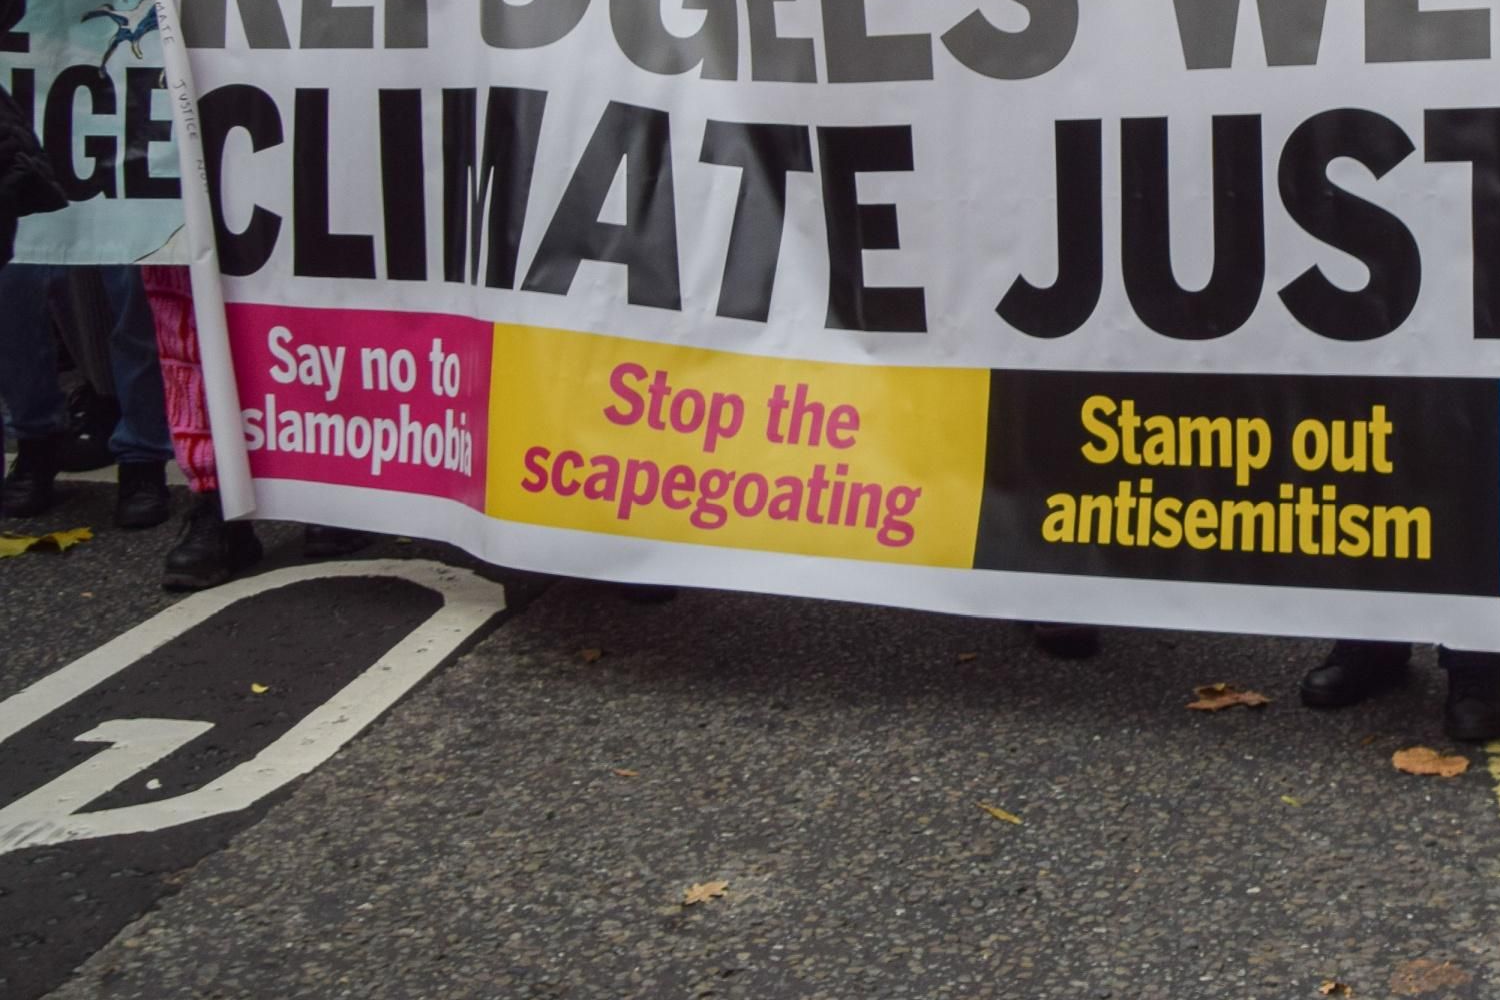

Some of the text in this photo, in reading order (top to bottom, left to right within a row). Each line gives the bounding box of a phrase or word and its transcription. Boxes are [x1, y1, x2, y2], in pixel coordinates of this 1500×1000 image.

[199, 83, 928, 335] CLIMATE
[269, 326, 462, 401] Say no to
[602, 361, 861, 453] Stop the
[241, 393, 473, 478] slamophobia
[1079, 394, 1394, 486] Stamp out
[521, 446, 922, 549] scapegoating
[1041, 478, 1433, 560] antisemitism
